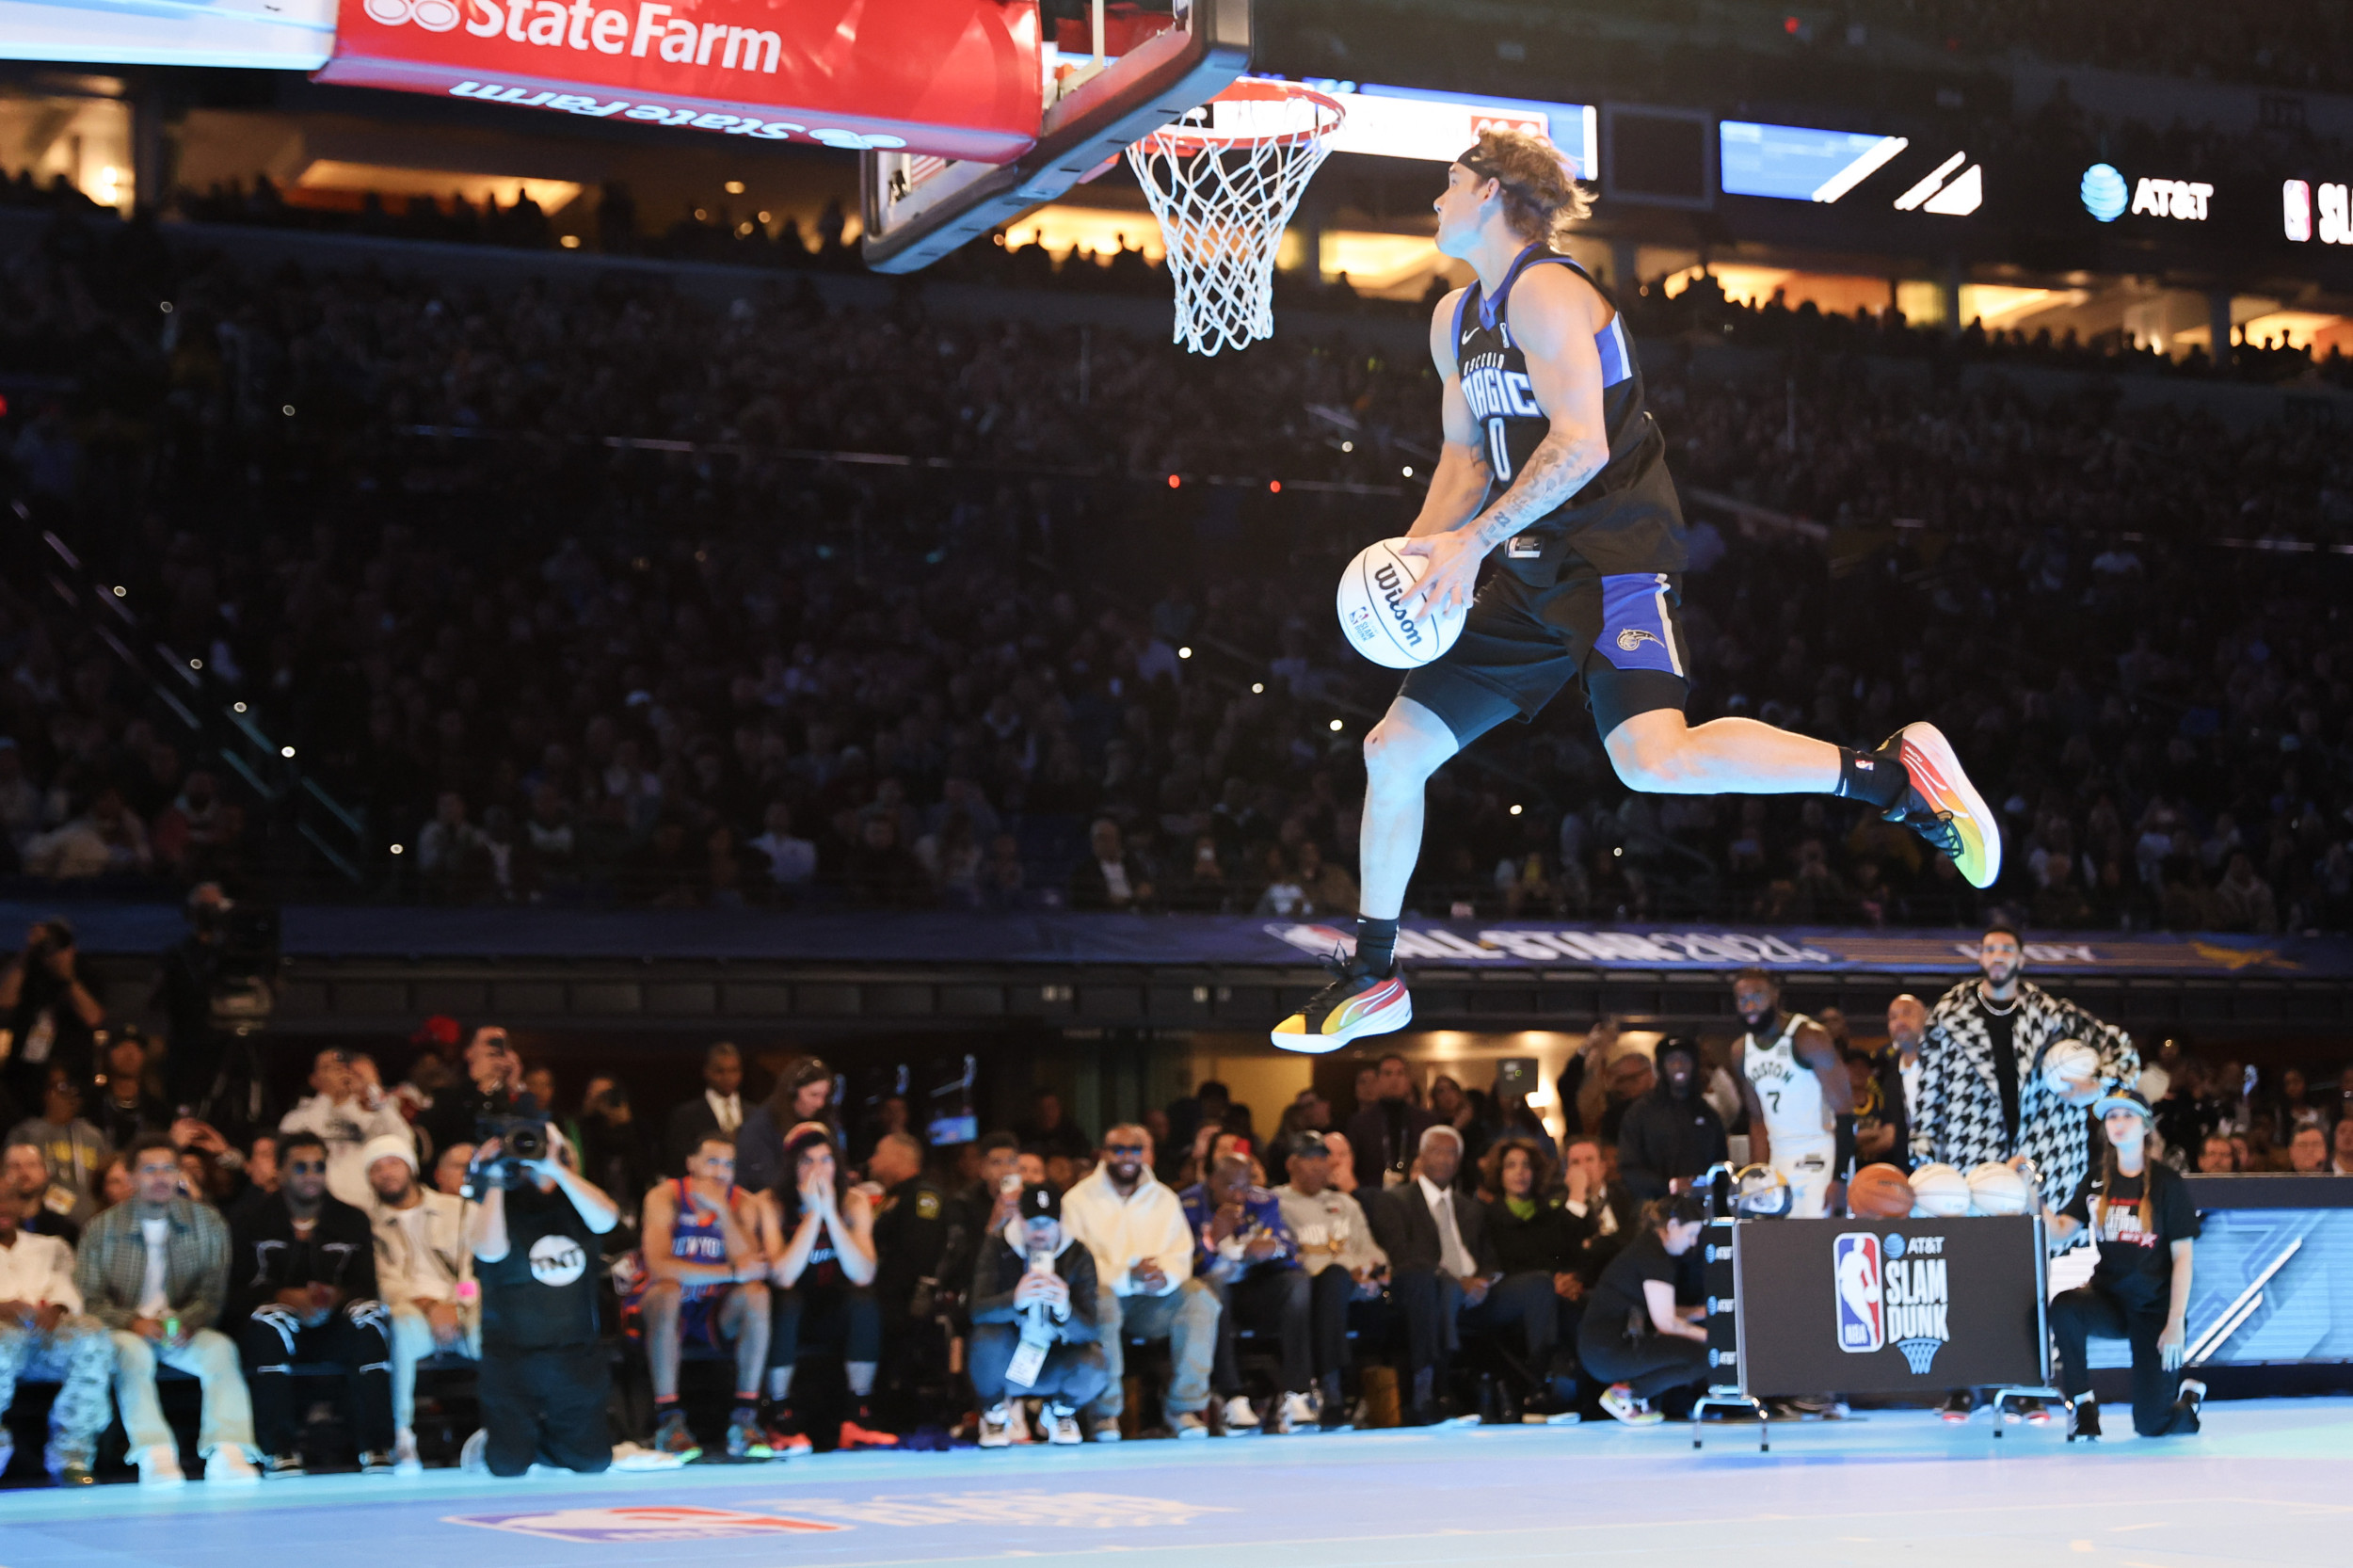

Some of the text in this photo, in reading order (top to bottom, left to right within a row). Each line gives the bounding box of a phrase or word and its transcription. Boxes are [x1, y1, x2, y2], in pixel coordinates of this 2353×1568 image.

[2131, 177, 2215, 221] AT&T
[2317, 182, 2353, 245] SL
[1460, 367, 1544, 424] MAGIC
[1488, 417, 1512, 482] 0
[1374, 562, 1423, 648] Wilson
[1767, 1091, 1781, 1113] 7
[1907, 1236, 1945, 1255] AT&T
[1885, 1258, 1948, 1306] SLAM
[1844, 1322, 1869, 1345] NBA
[1887, 1303, 1950, 1345] DUNK
